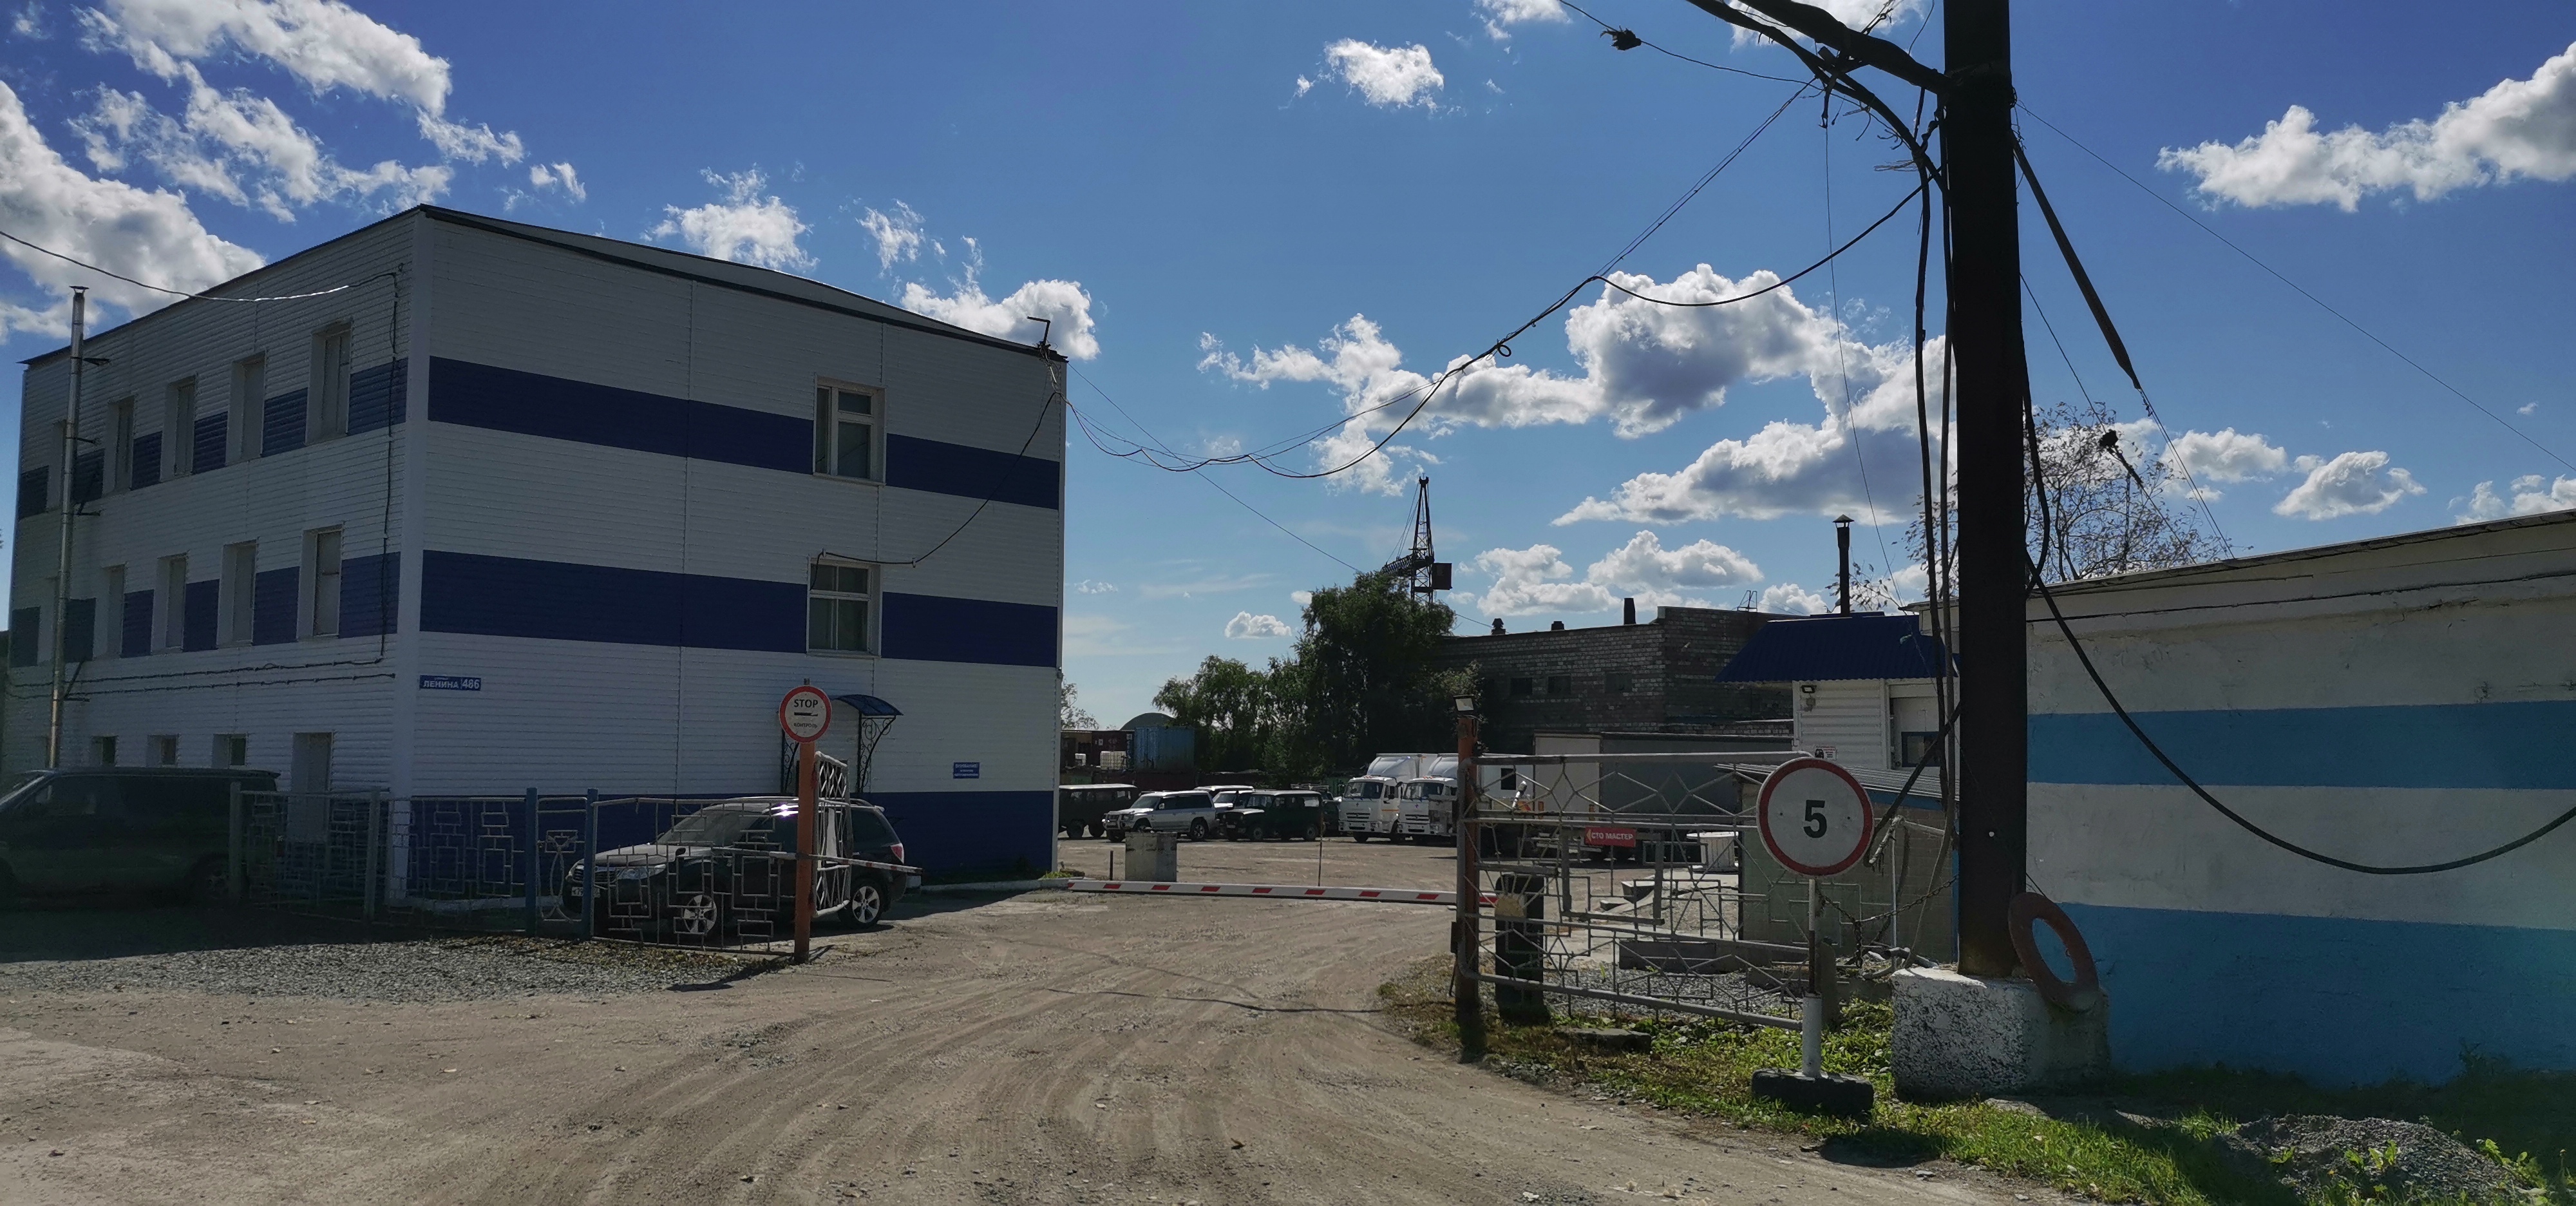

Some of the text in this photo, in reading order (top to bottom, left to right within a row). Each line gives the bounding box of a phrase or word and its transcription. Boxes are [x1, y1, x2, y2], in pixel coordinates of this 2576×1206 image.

[423, 678, 480, 689] ЛЕНИНА 486
[793, 699, 819, 708] STOP
[1803, 799, 1828, 838] 5
